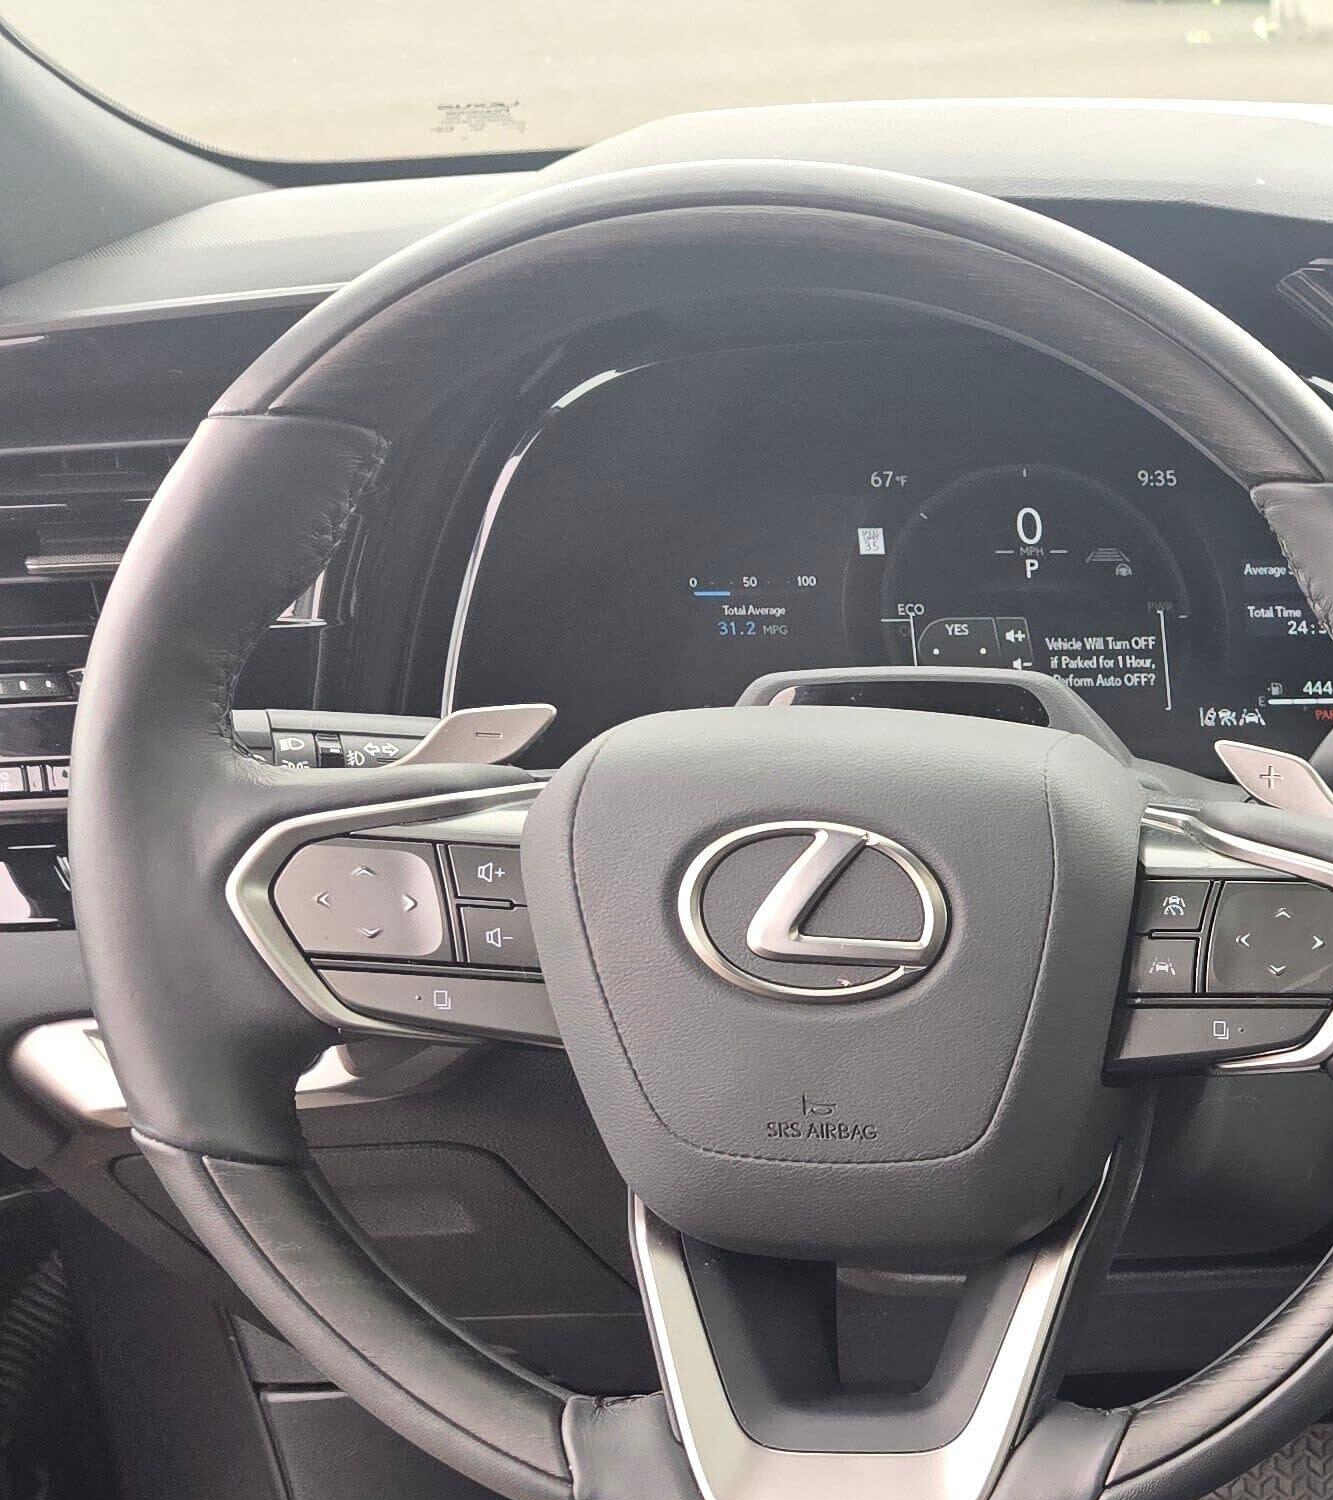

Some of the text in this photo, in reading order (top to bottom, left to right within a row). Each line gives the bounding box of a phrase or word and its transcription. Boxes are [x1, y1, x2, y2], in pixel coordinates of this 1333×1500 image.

[1137, 469, 1178, 487] 9:35
[1016, 507, 1043, 545] 0
[1024, 558, 1039, 579] P
[1243, 563, 1287, 577] Average
[689, 577, 698, 587] 0
[742, 576, 758, 587] 50
[796, 575, 817, 587] 100
[722, 605, 786, 617] Total Average
[897, 603, 925, 616] ECO
[1246, 605, 1302, 618] Total Time
[717, 621, 789, 636] 31.2 MPG
[944, 623, 970, 636] YES
[1044, 636, 1156, 651] Vehicle Will Turn OFF
[1050, 655, 1156, 669] if Parked for 1 Hour,
[1095, 674, 1123, 688] Auto
[1123, 673, 1156, 687] OFF?
[1302, 680, 1333, 696] 444
[766, 1121, 878, 1140] SRS AIRBAG
